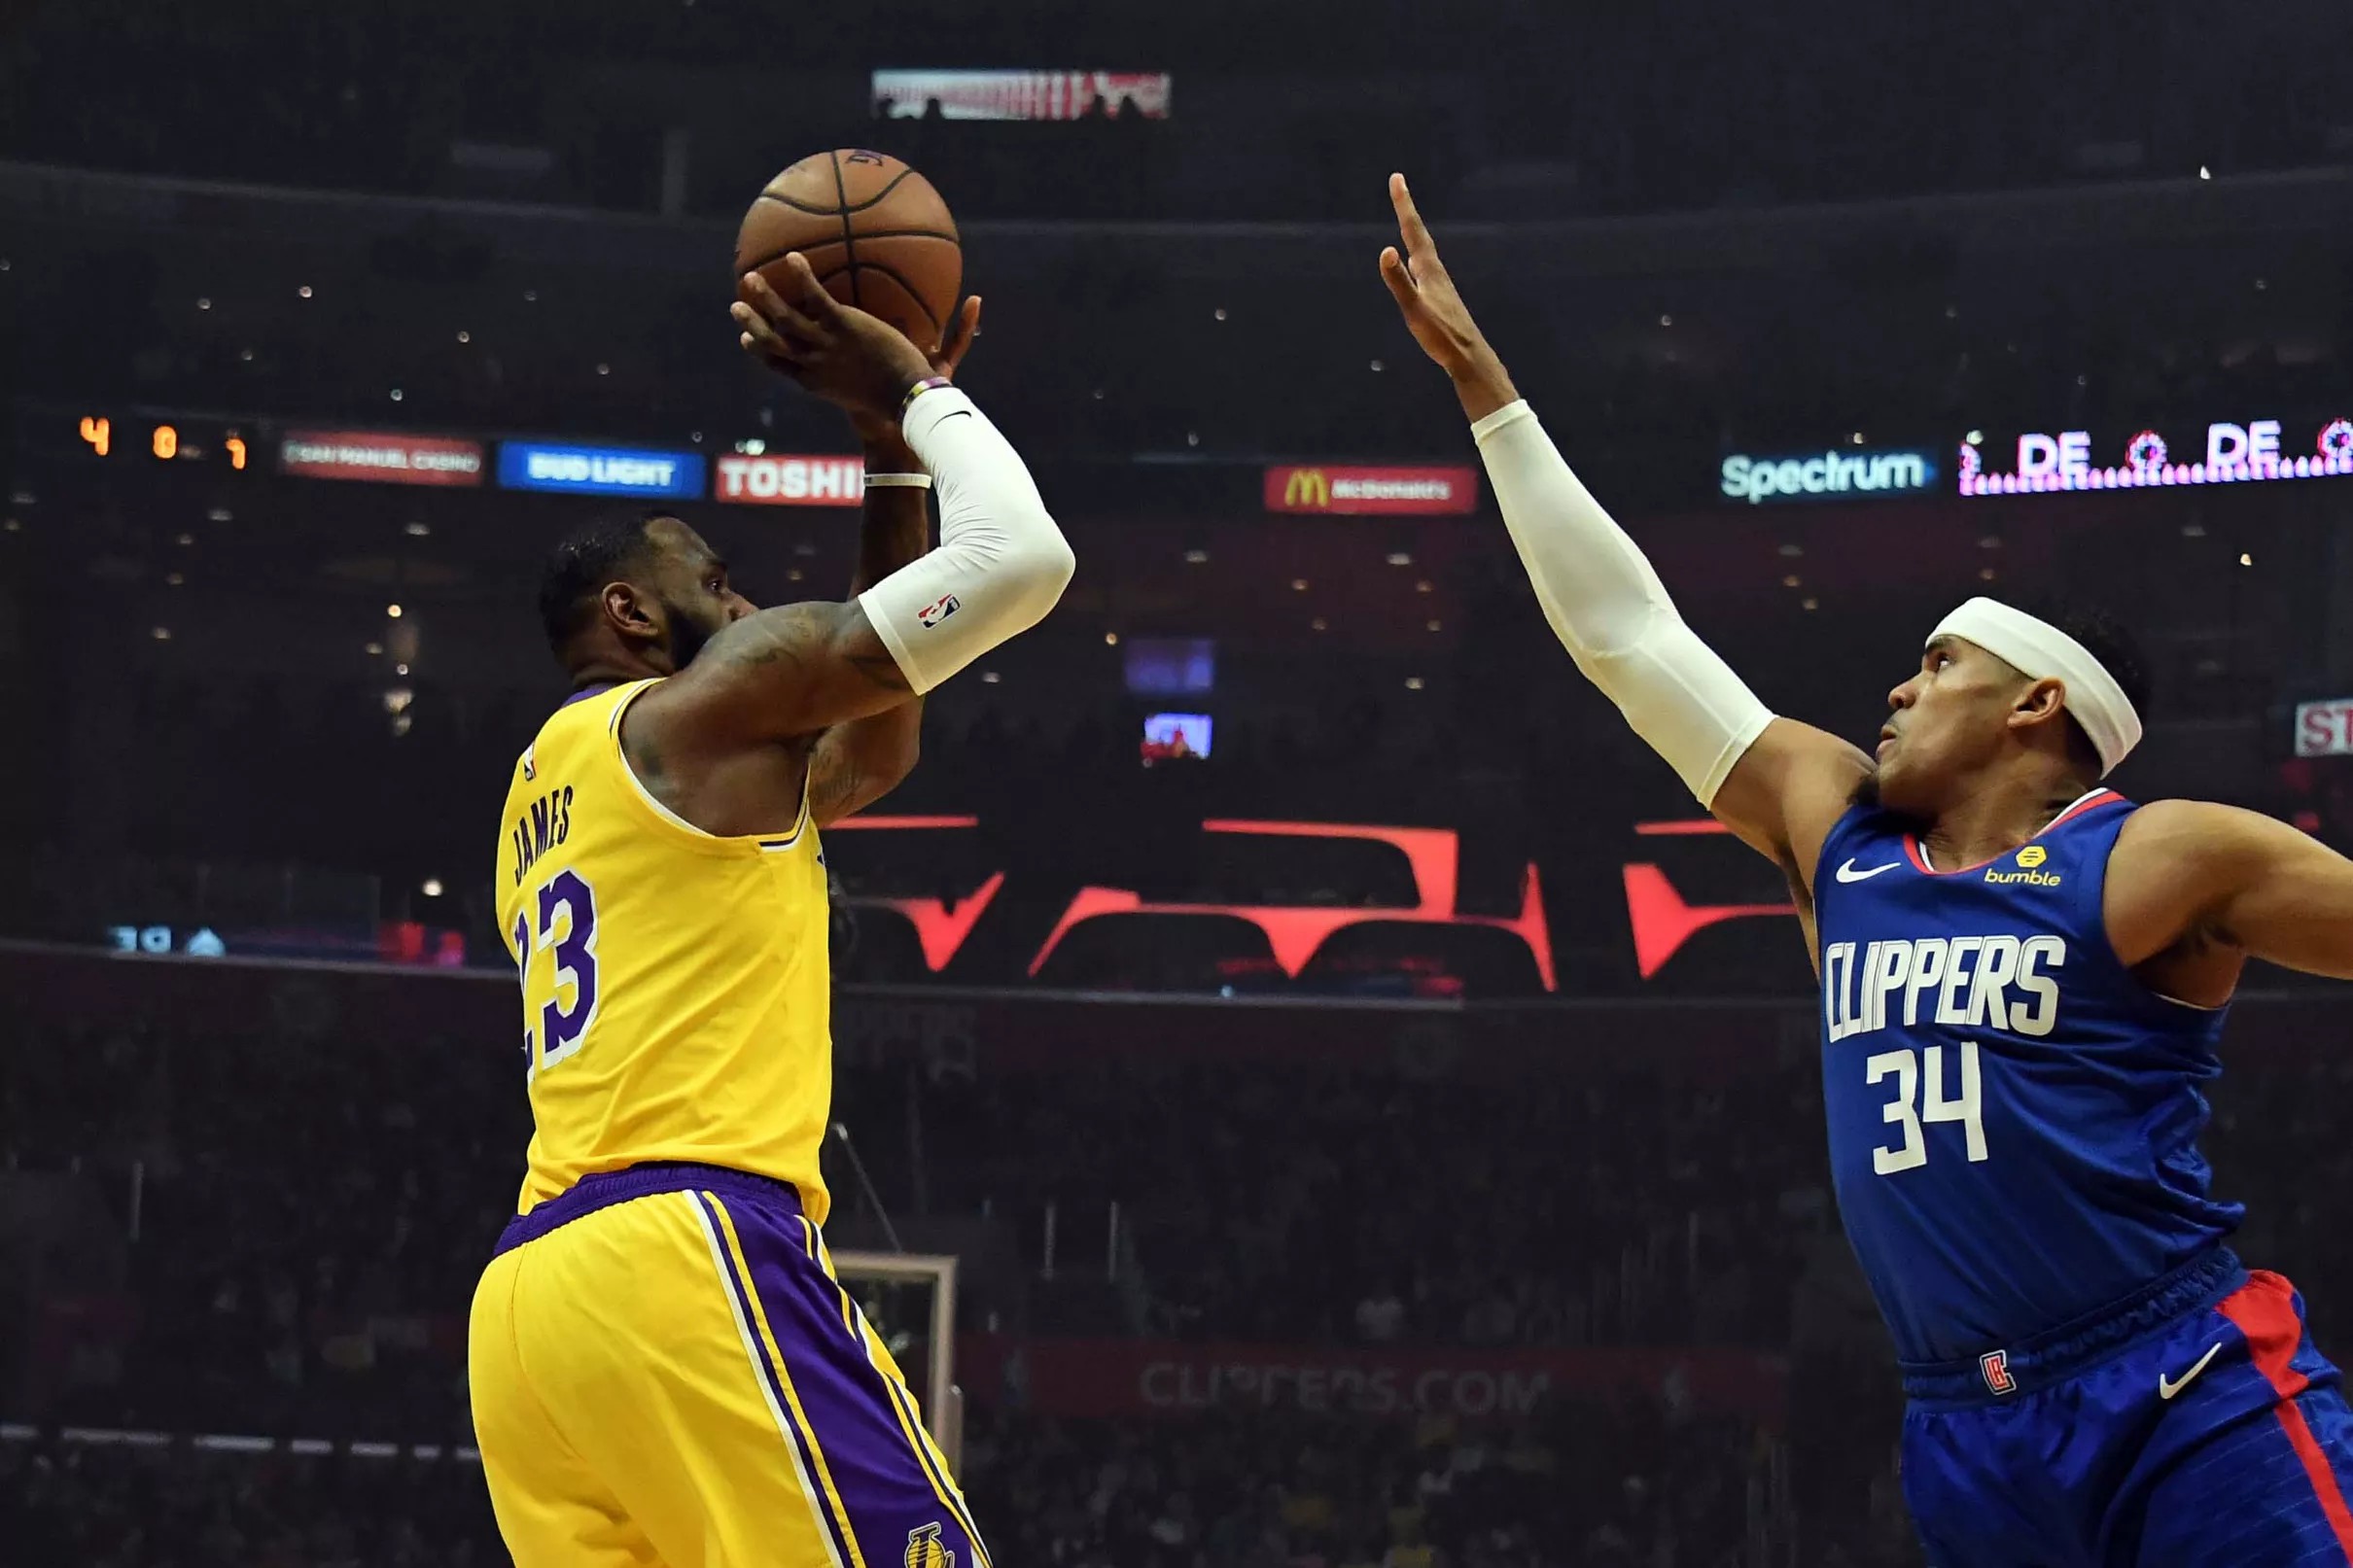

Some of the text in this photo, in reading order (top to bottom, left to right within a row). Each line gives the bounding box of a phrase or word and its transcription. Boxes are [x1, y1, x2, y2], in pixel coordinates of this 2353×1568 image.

[527, 452, 675, 486] BUD LIGHT
[720, 458, 864, 499] TOSHI
[1721, 449, 1923, 505] Spectrum
[513, 784, 574, 888] JAMES
[1984, 868, 2061, 887] bumble
[1826, 934, 2066, 1043] CLIPPERS
[1865, 1040, 1988, 1175] 34
